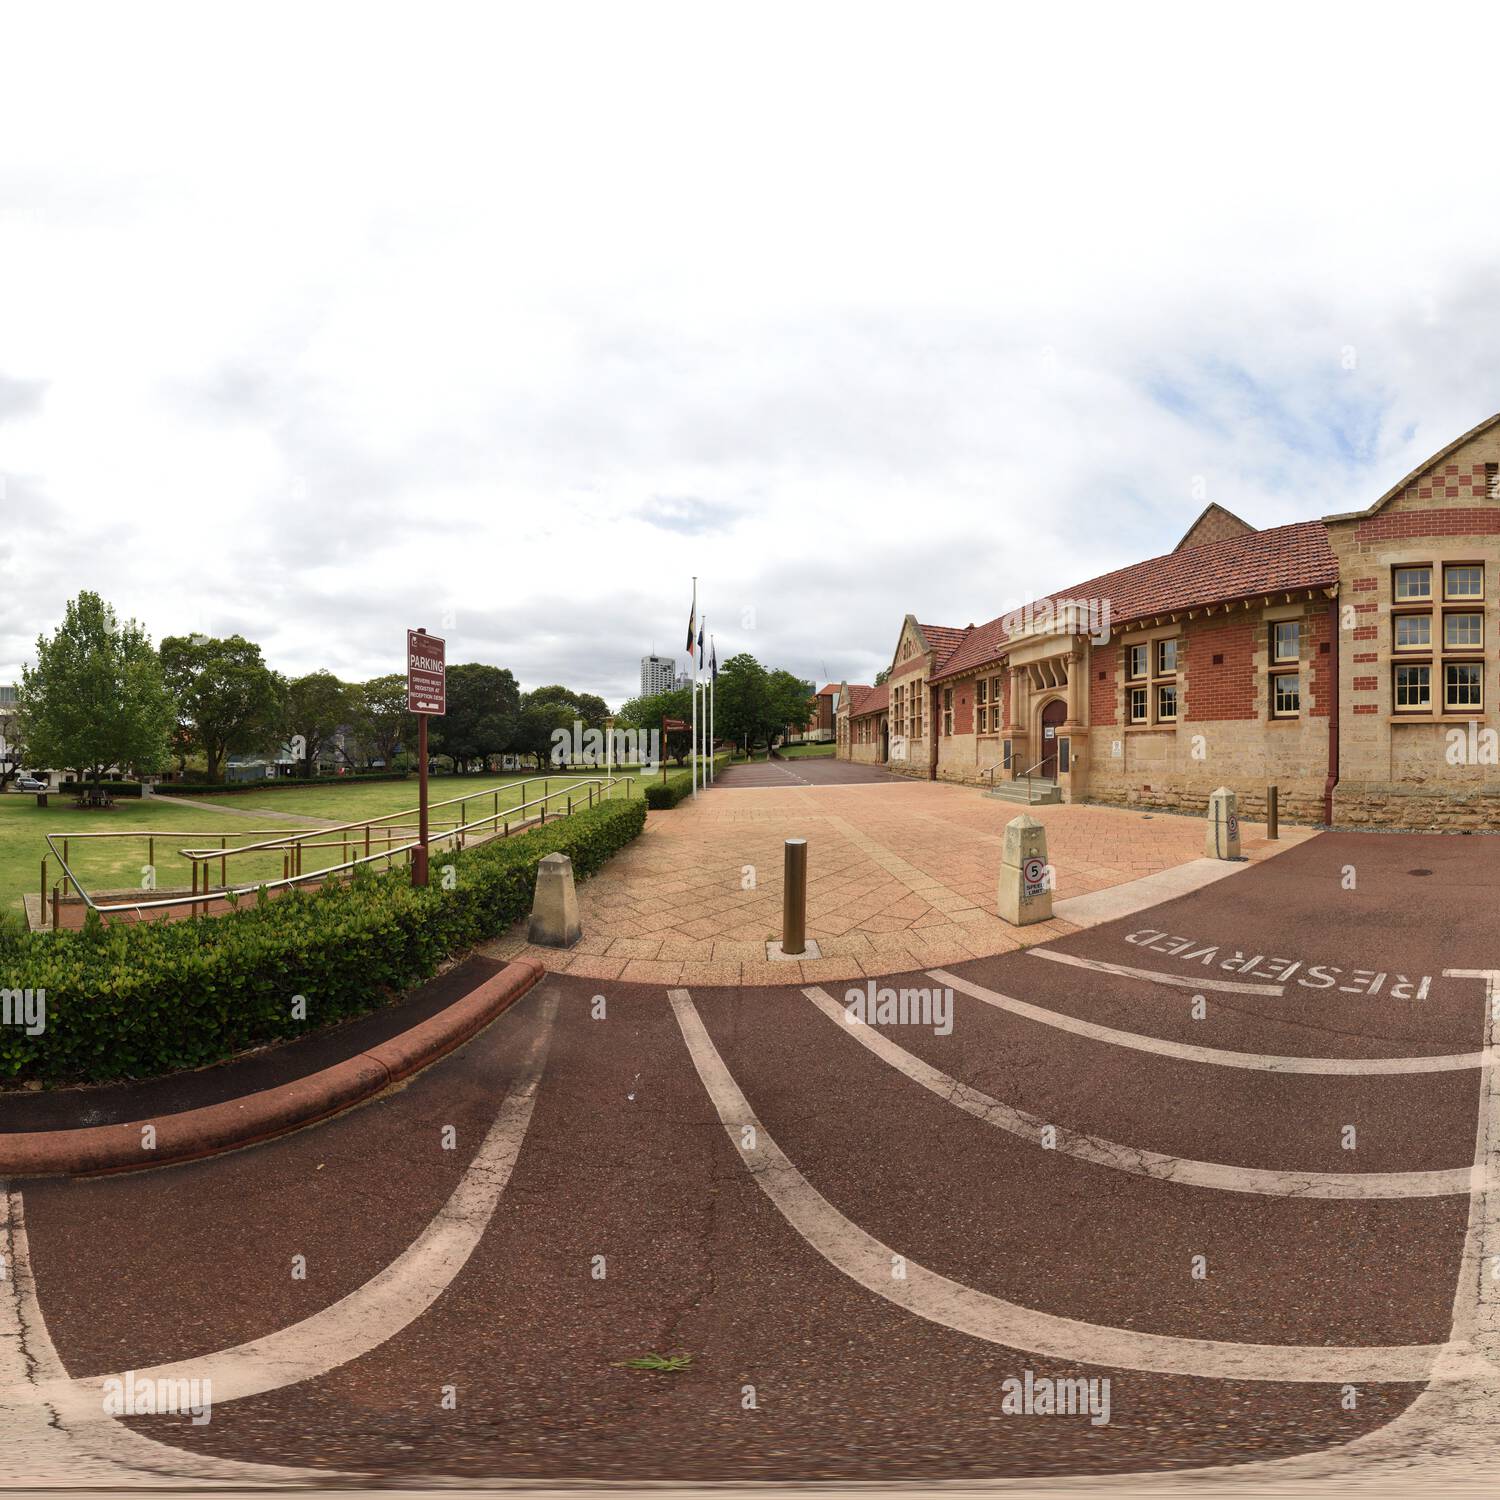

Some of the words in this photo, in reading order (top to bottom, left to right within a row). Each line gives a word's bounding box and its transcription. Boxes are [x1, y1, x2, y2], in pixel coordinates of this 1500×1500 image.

[410, 654, 443, 673] PARKING
[1031, 865, 1039, 877] 5
[1124, 929, 1432, 1000] RESERVED
